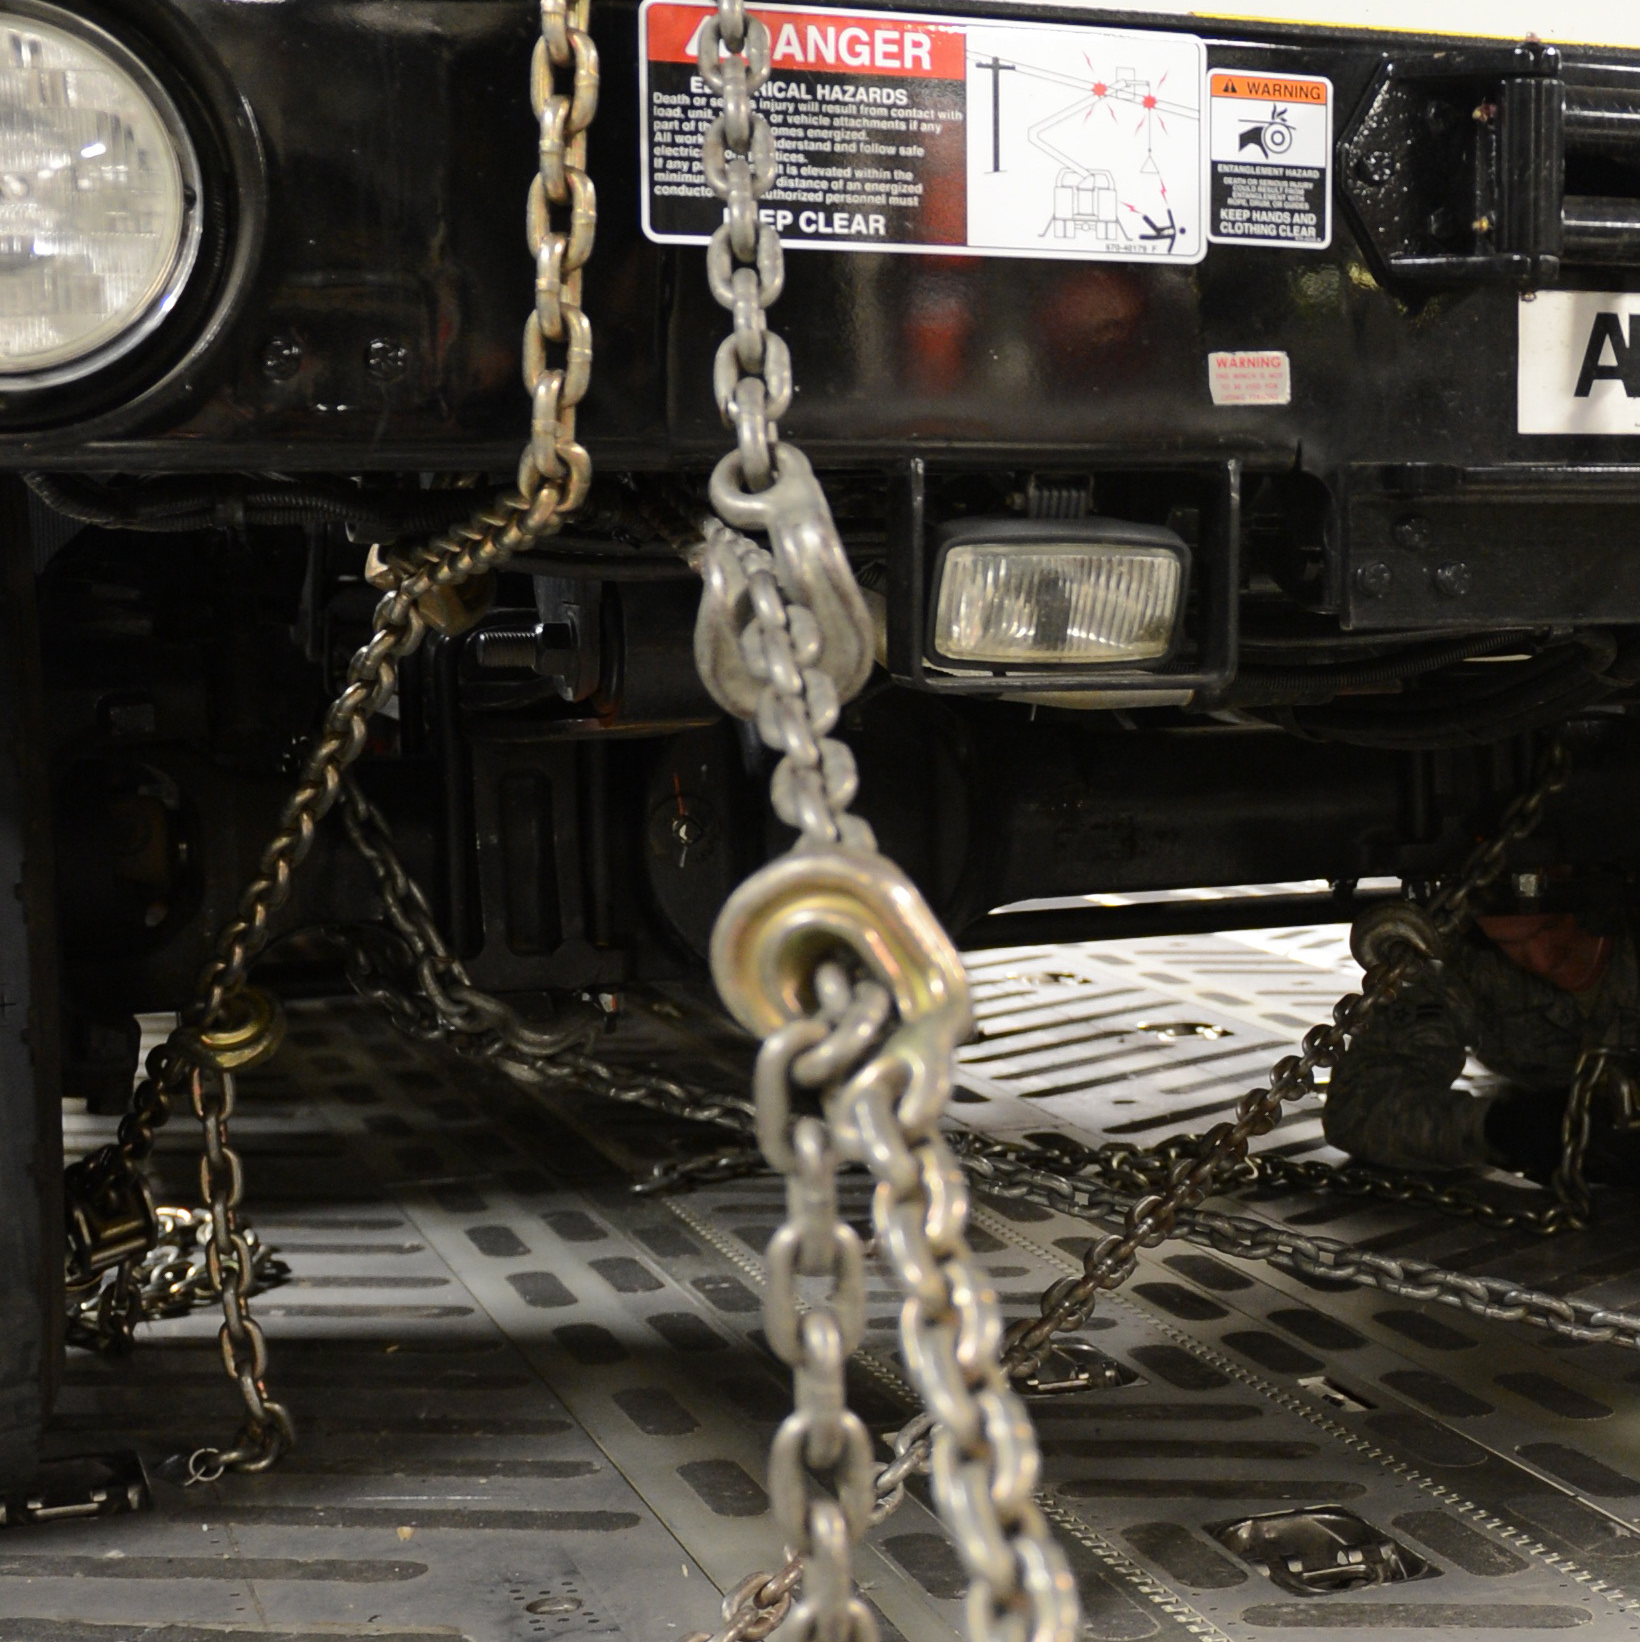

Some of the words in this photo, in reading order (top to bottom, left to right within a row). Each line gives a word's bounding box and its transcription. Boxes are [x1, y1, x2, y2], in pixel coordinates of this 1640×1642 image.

[745, 15, 932, 70] ANGER
[816, 83, 909, 106] HAZARDS
[1247, 82, 1321, 100] WARNING
[653, 91, 691, 106] Death
[693, 96, 707, 107] or
[759, 98, 796, 113] injury
[797, 101, 820, 113] will
[821, 103, 857, 115] result
[859, 105, 889, 117] from
[890, 107, 936, 120] contact
[937, 109, 963, 121] with
[653, 120, 680, 133] part
[681, 120, 696, 132] of
[806, 128, 870, 142] energized.
[769, 114, 784, 124] or
[786, 113, 832, 127] vehicle
[832, 115, 907, 131] attachments
[909, 120, 919, 130] if
[920, 121, 942, 135] any
[653, 132, 672, 143] All
[774, 139, 832, 153] derstand
[833, 141, 857, 153] and
[859, 143, 898, 156] follow
[899, 145, 925, 157] safe
[653, 158, 664, 169] If
[665, 160, 689, 172] any
[786, 164, 799, 176] is
[800, 165, 852, 179] elevated
[854, 168, 892, 180] within
[893, 169, 914, 181] the
[1217, 163, 1284, 176] ENTANGLEMENT
[1285, 168, 1320, 179] HAZARD
[775, 176, 829, 190] distance
[830, 179, 844, 190] of
[845, 180, 862, 192] an
[863, 181, 923, 196] energized
[825, 192, 887, 206] personnel
[888, 195, 919, 207] must
[798, 210, 887, 236] CLEAR
[1219, 208, 1251, 221] KEEP
[1251, 209, 1292, 224] HANDS
[1292, 212, 1318, 226] AND
[1219, 221, 1278, 237] CLOTHING
[1278, 225, 1317, 238] CLEAR
[1216, 355, 1282, 369] WARNING
